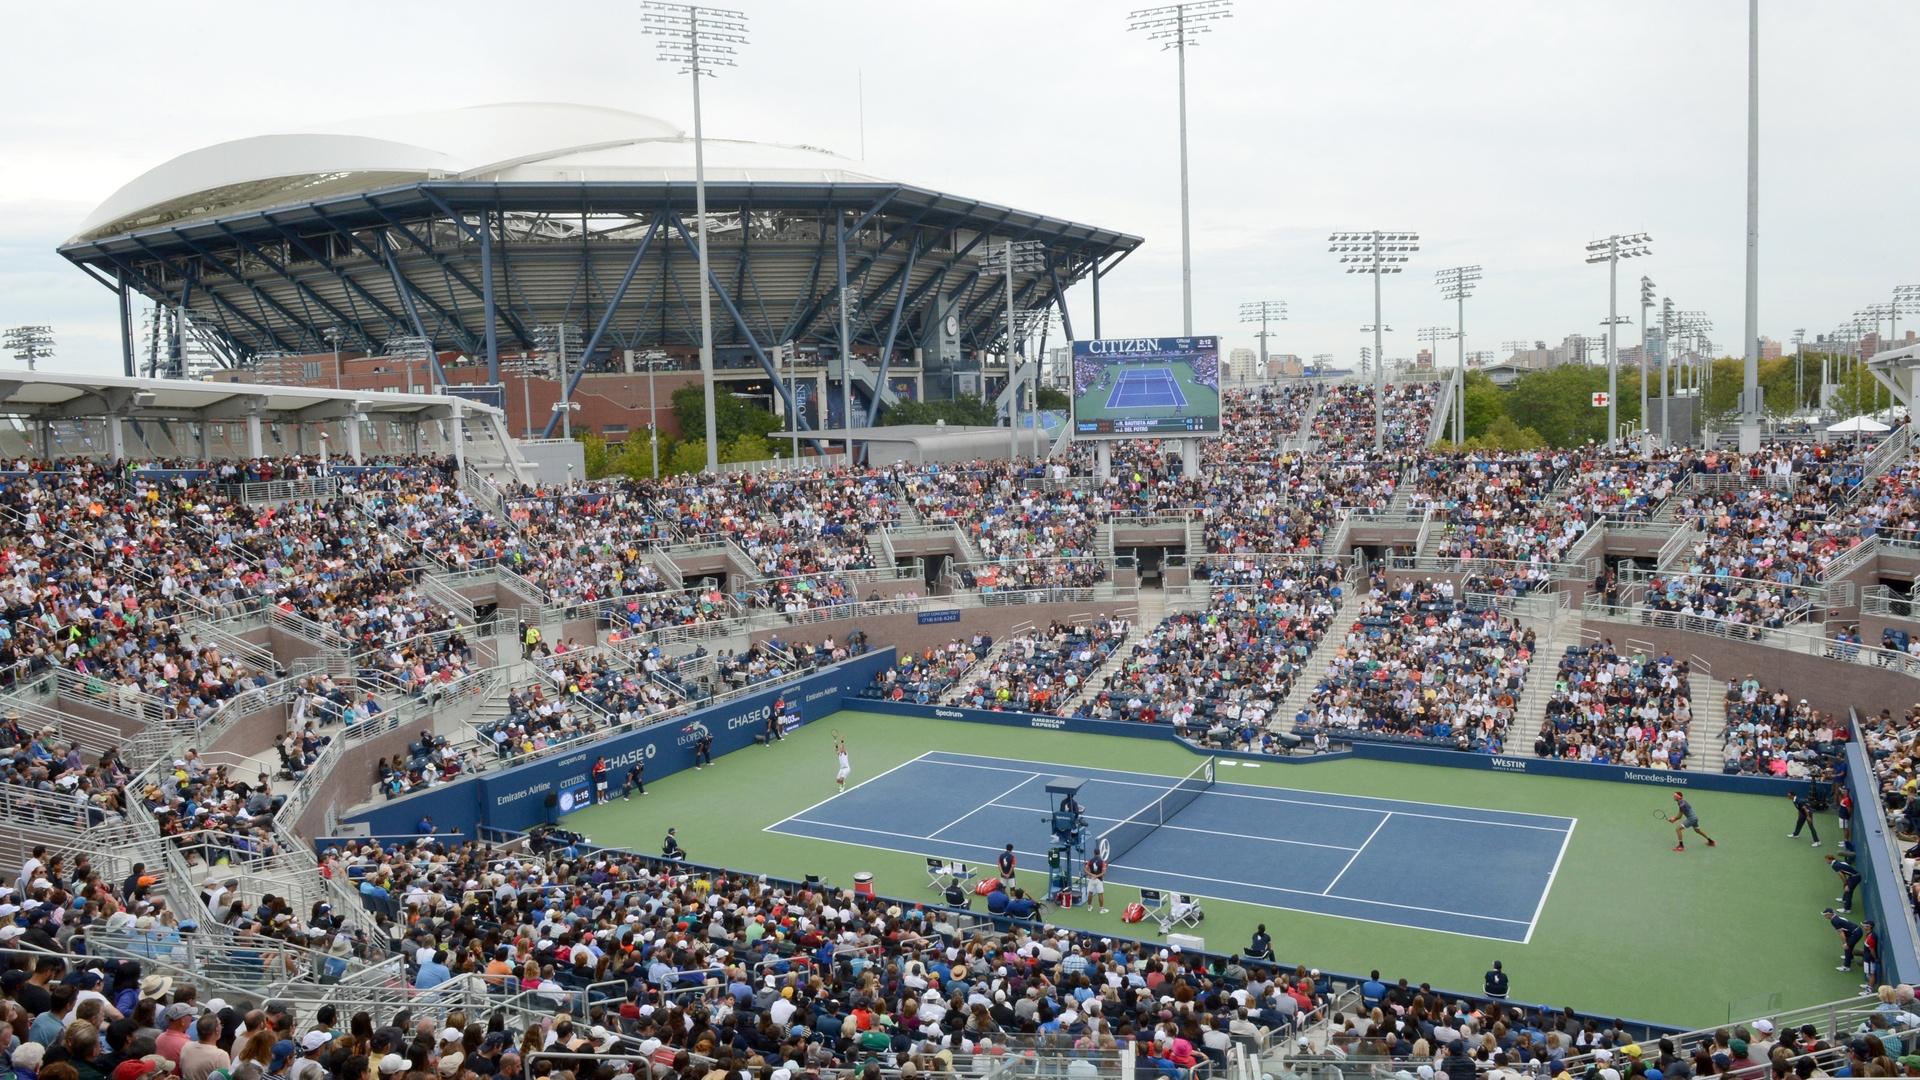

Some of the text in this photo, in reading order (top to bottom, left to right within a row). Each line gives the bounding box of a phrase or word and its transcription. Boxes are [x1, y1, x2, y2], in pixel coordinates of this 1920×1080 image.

[796, 384, 807, 415] OPEN
[727, 709, 761, 730] CHASE
[935, 709, 961, 718] Spectrum
[1032, 717, 1066, 725] AMERICAN
[677, 736, 686, 746] US
[557, 753, 587, 767] usopen.org
[1491, 757, 1526, 769] WESTIN
[559, 773, 587, 789] CITIZEN
[1624, 771, 1688, 785] Mercedes-Benz
[497, 781, 552, 806] Emirates Airline
[574, 790, 589, 802] 1:15
